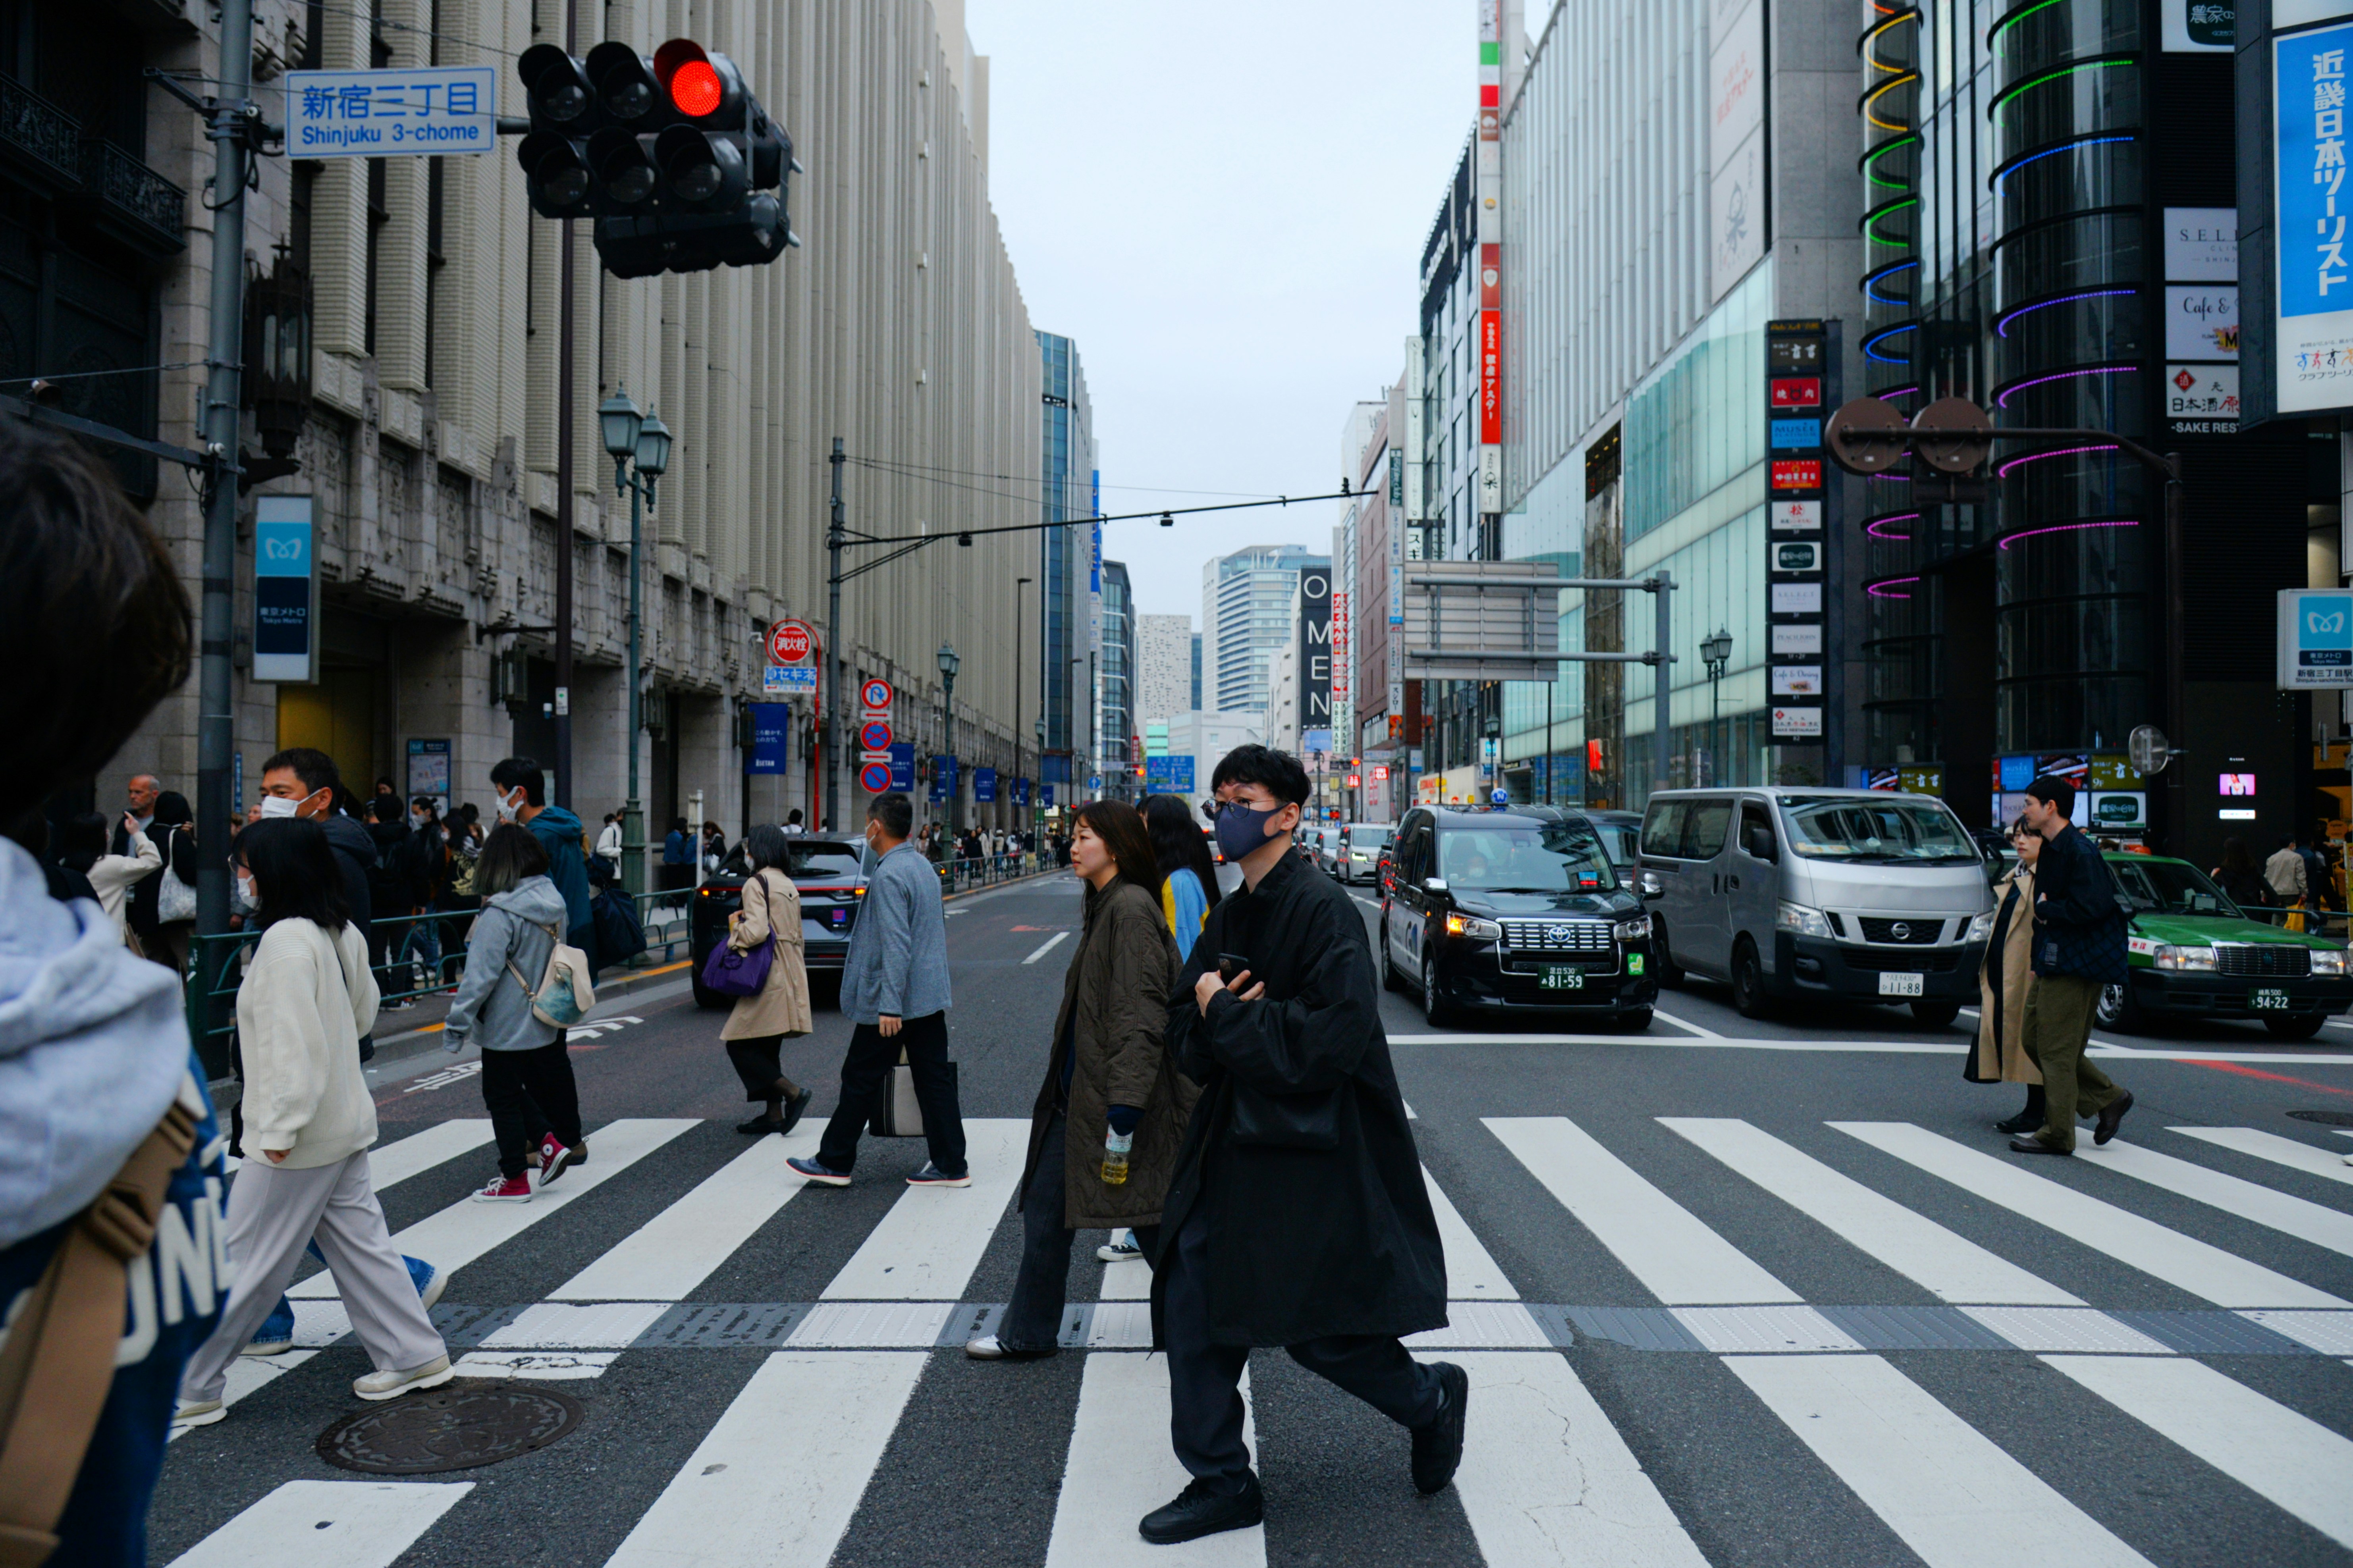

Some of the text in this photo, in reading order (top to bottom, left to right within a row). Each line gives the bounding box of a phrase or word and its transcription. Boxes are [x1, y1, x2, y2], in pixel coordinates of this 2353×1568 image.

[302, 82, 477, 119] 新宿三丁目
[302, 122, 479, 147] Shinjuku 3-chome
[2313, 49, 2348, 296] 近畿日本ツーリスト
[2184, 297, 2230, 321] Cafe &
[1485, 353, 1497, 420] 銀座アスター
[260, 607, 306, 616] 東京メトロ
[777, 636, 807, 651] 消火栓
[777, 668, 816, 680] セキネ
[755, 758, 775, 767] ISETAN
[2092, 777, 2104, 787] 9F
[1548, 975, 1582, 988] 81-59
[1890, 982, 1920, 994] 11-88
[2257, 996, 2288, 1008] 94-22
